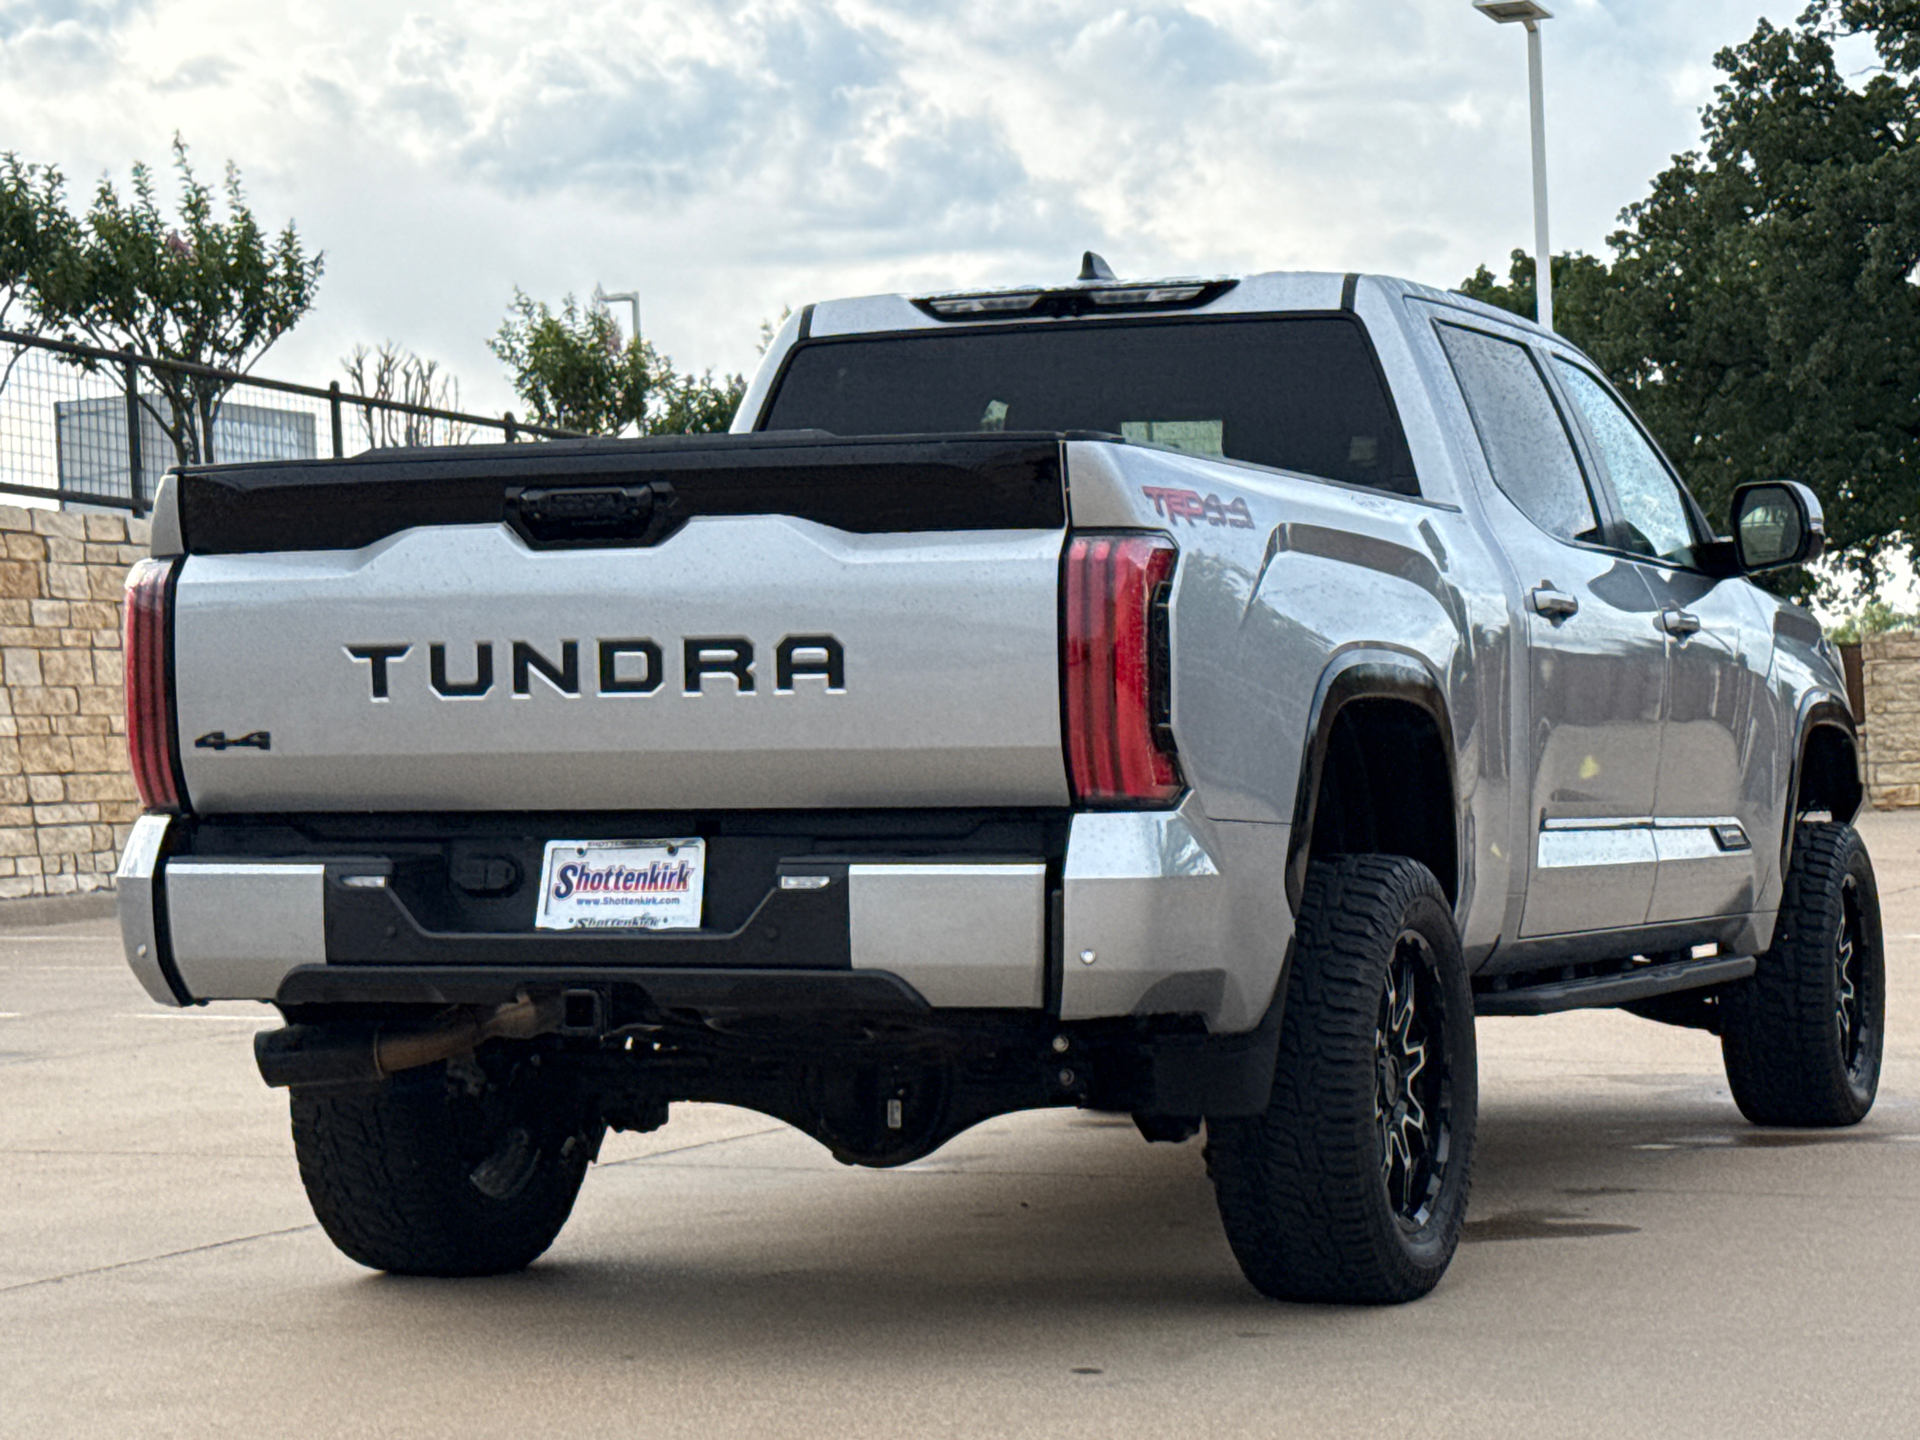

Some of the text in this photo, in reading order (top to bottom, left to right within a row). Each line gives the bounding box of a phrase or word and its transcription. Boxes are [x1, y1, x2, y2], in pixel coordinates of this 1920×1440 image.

[1142, 485, 1206, 527] TRD
[343, 633, 847, 702] TUNDRA
[553, 861, 694, 901] Shottenkirk
[576, 895, 680, 906] www.Shottenkirk.com
